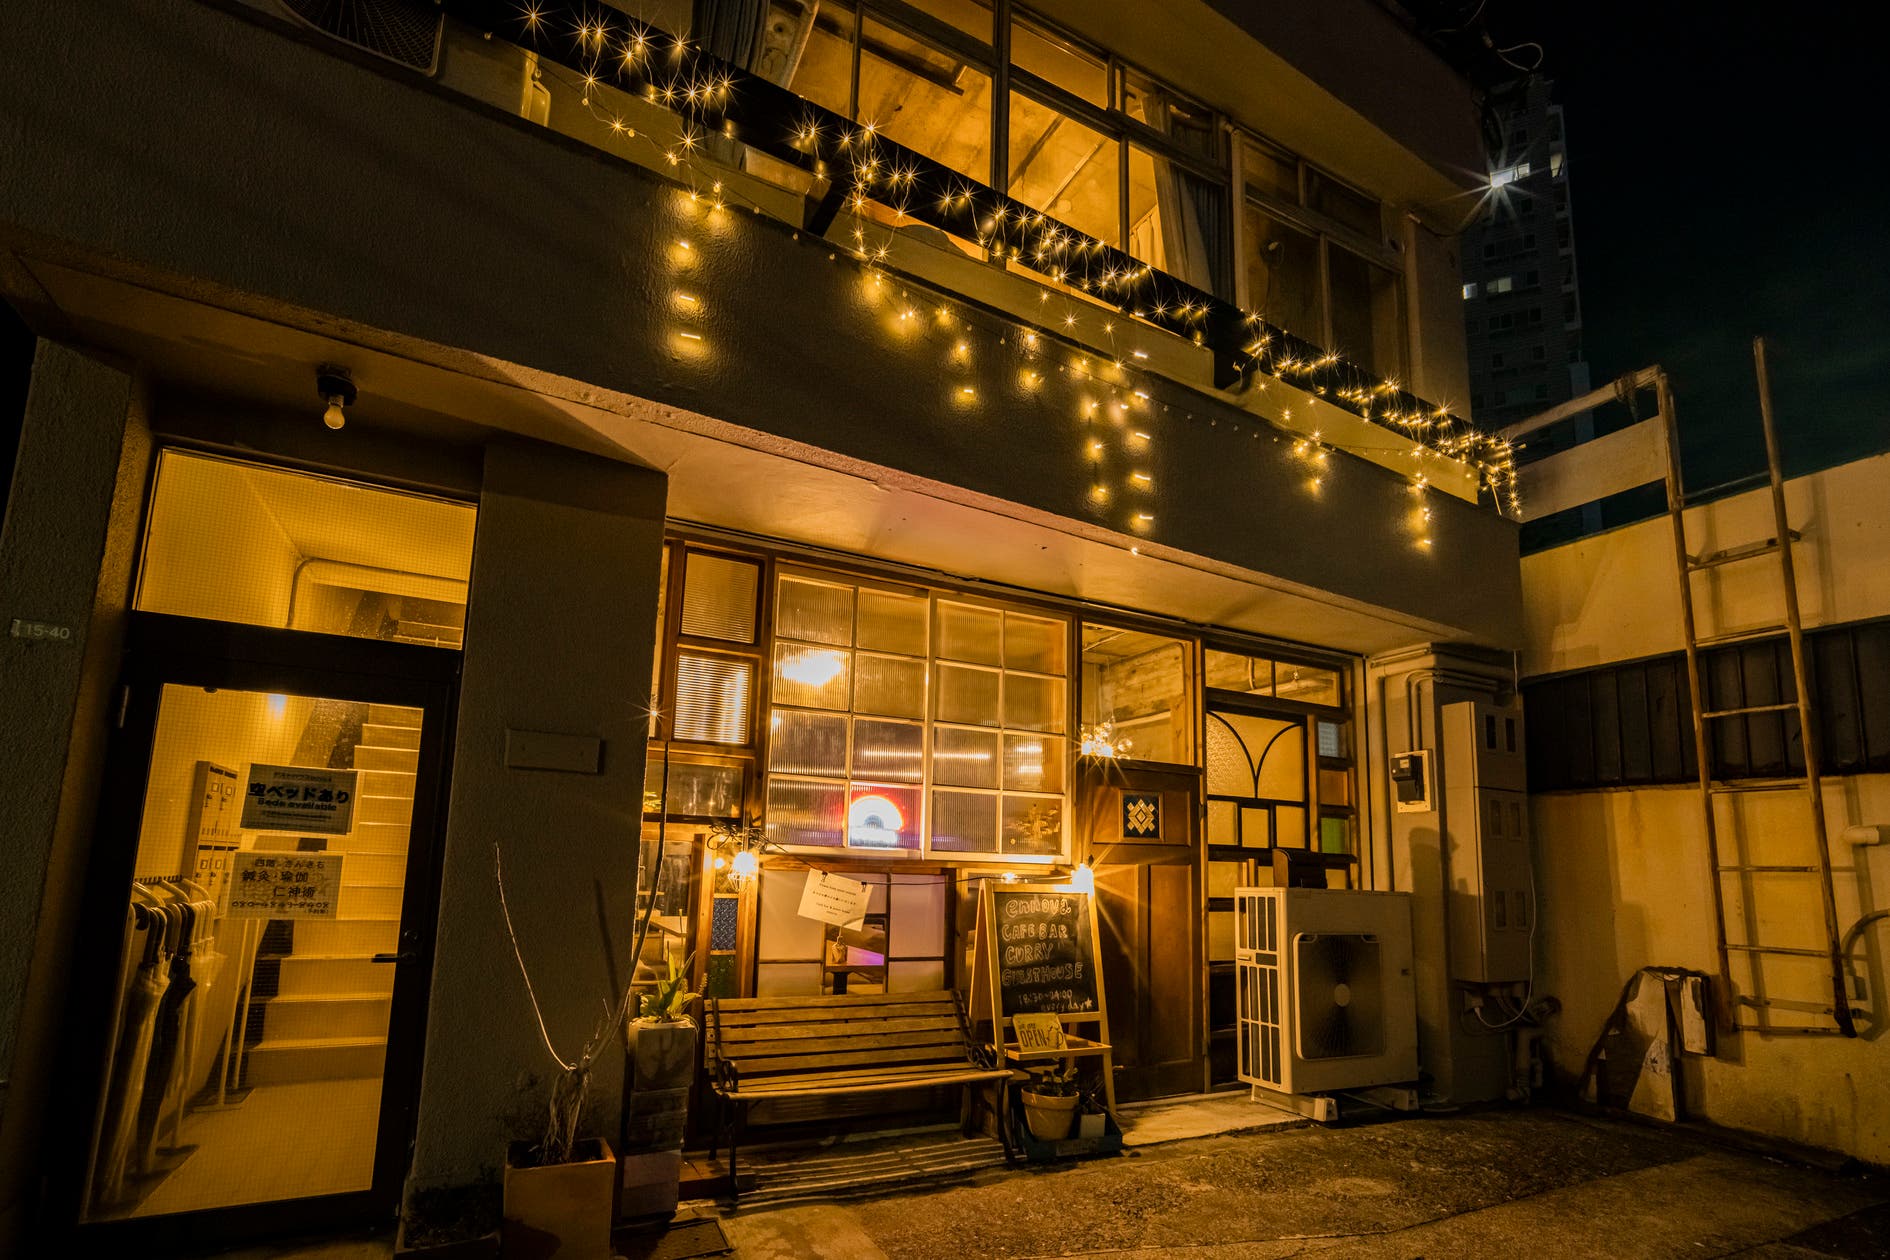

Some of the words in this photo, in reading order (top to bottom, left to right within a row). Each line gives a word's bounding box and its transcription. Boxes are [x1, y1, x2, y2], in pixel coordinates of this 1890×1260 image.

[27, 623, 70, 639] 15-40
[248, 783, 349, 803] 空ベッドあり
[258, 797, 286, 807] Beds
[288, 801, 337, 812] available
[1001, 923, 1036, 941] CAFE
[1039, 922, 1068, 940] BAR
[1005, 943, 1054, 965] CURRY
[1020, 1029, 1048, 1048] OPEN
